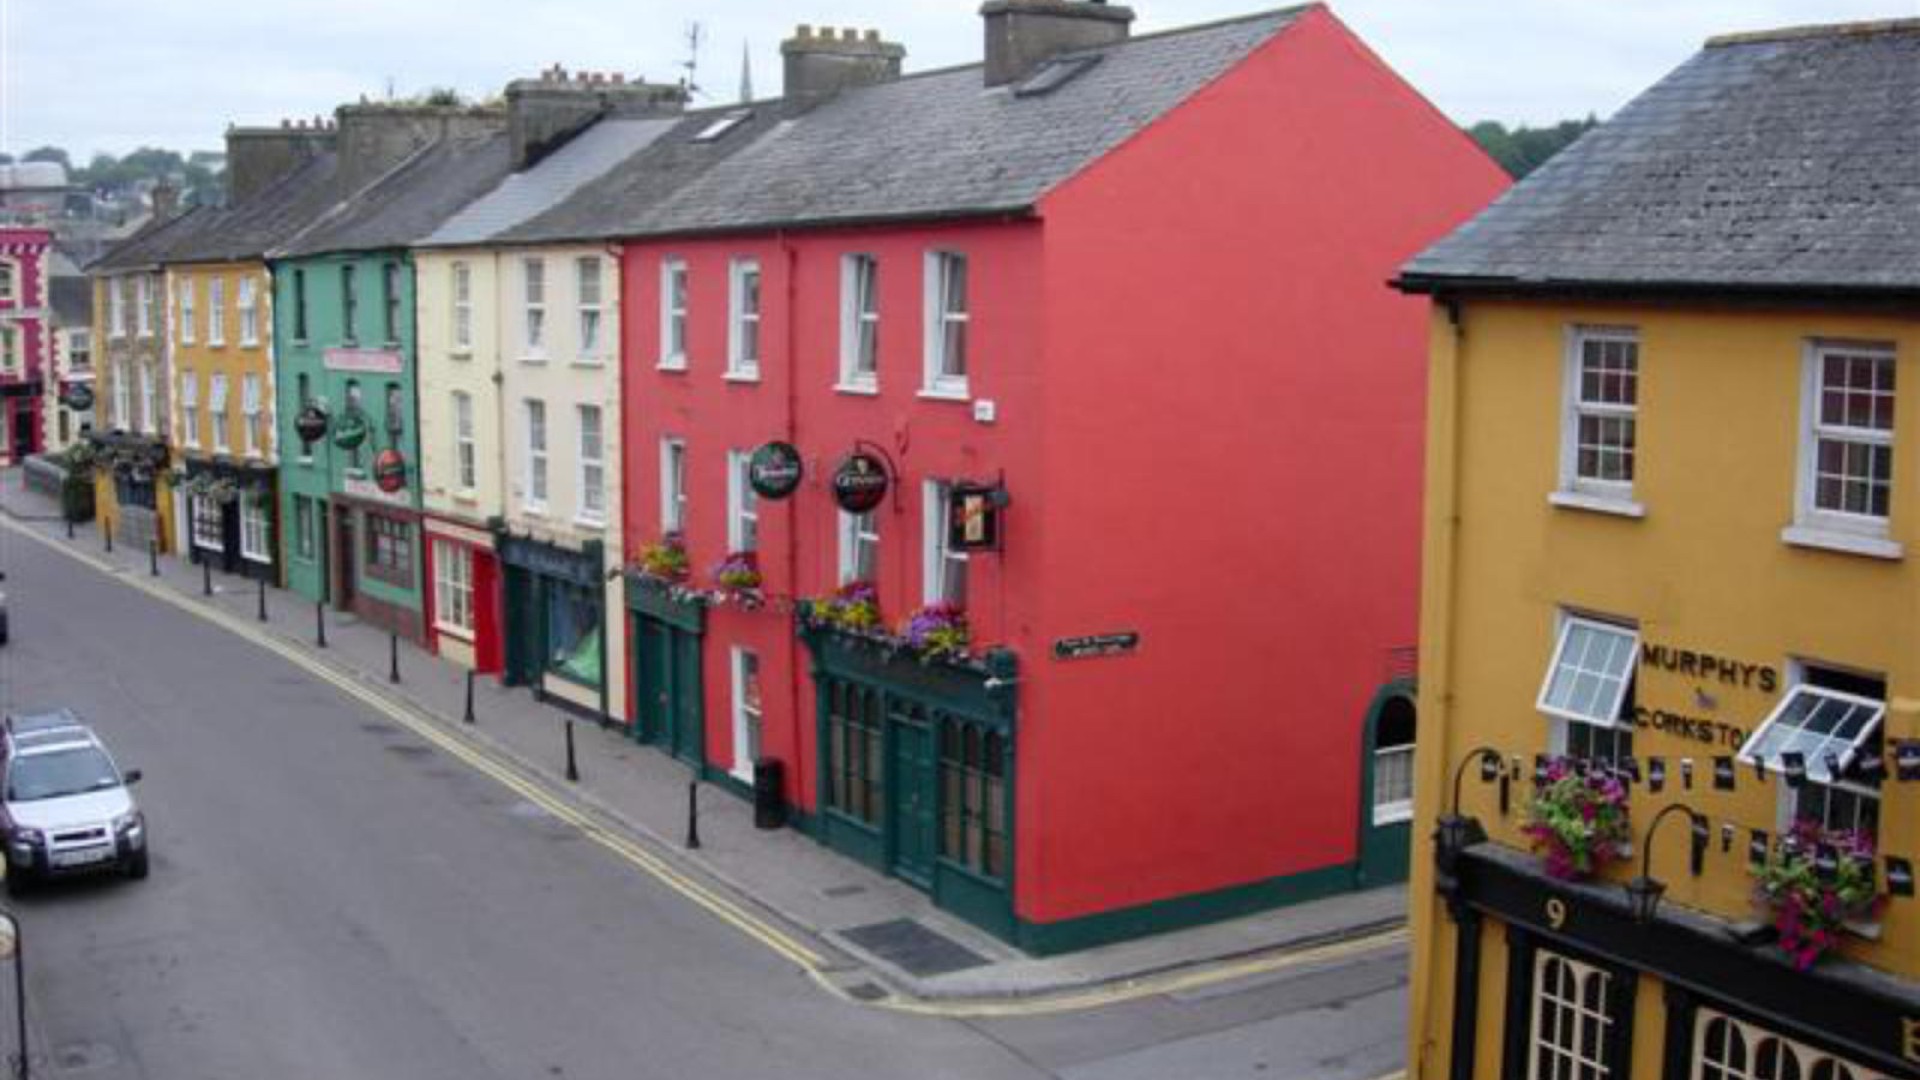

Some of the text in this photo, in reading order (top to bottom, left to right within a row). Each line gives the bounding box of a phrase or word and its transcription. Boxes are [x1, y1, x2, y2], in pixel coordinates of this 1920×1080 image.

[1642, 642, 1777, 693] MURPHYS
[1633, 706, 1752, 751] CORKSTO
[1547, 899, 1565, 929] 9
